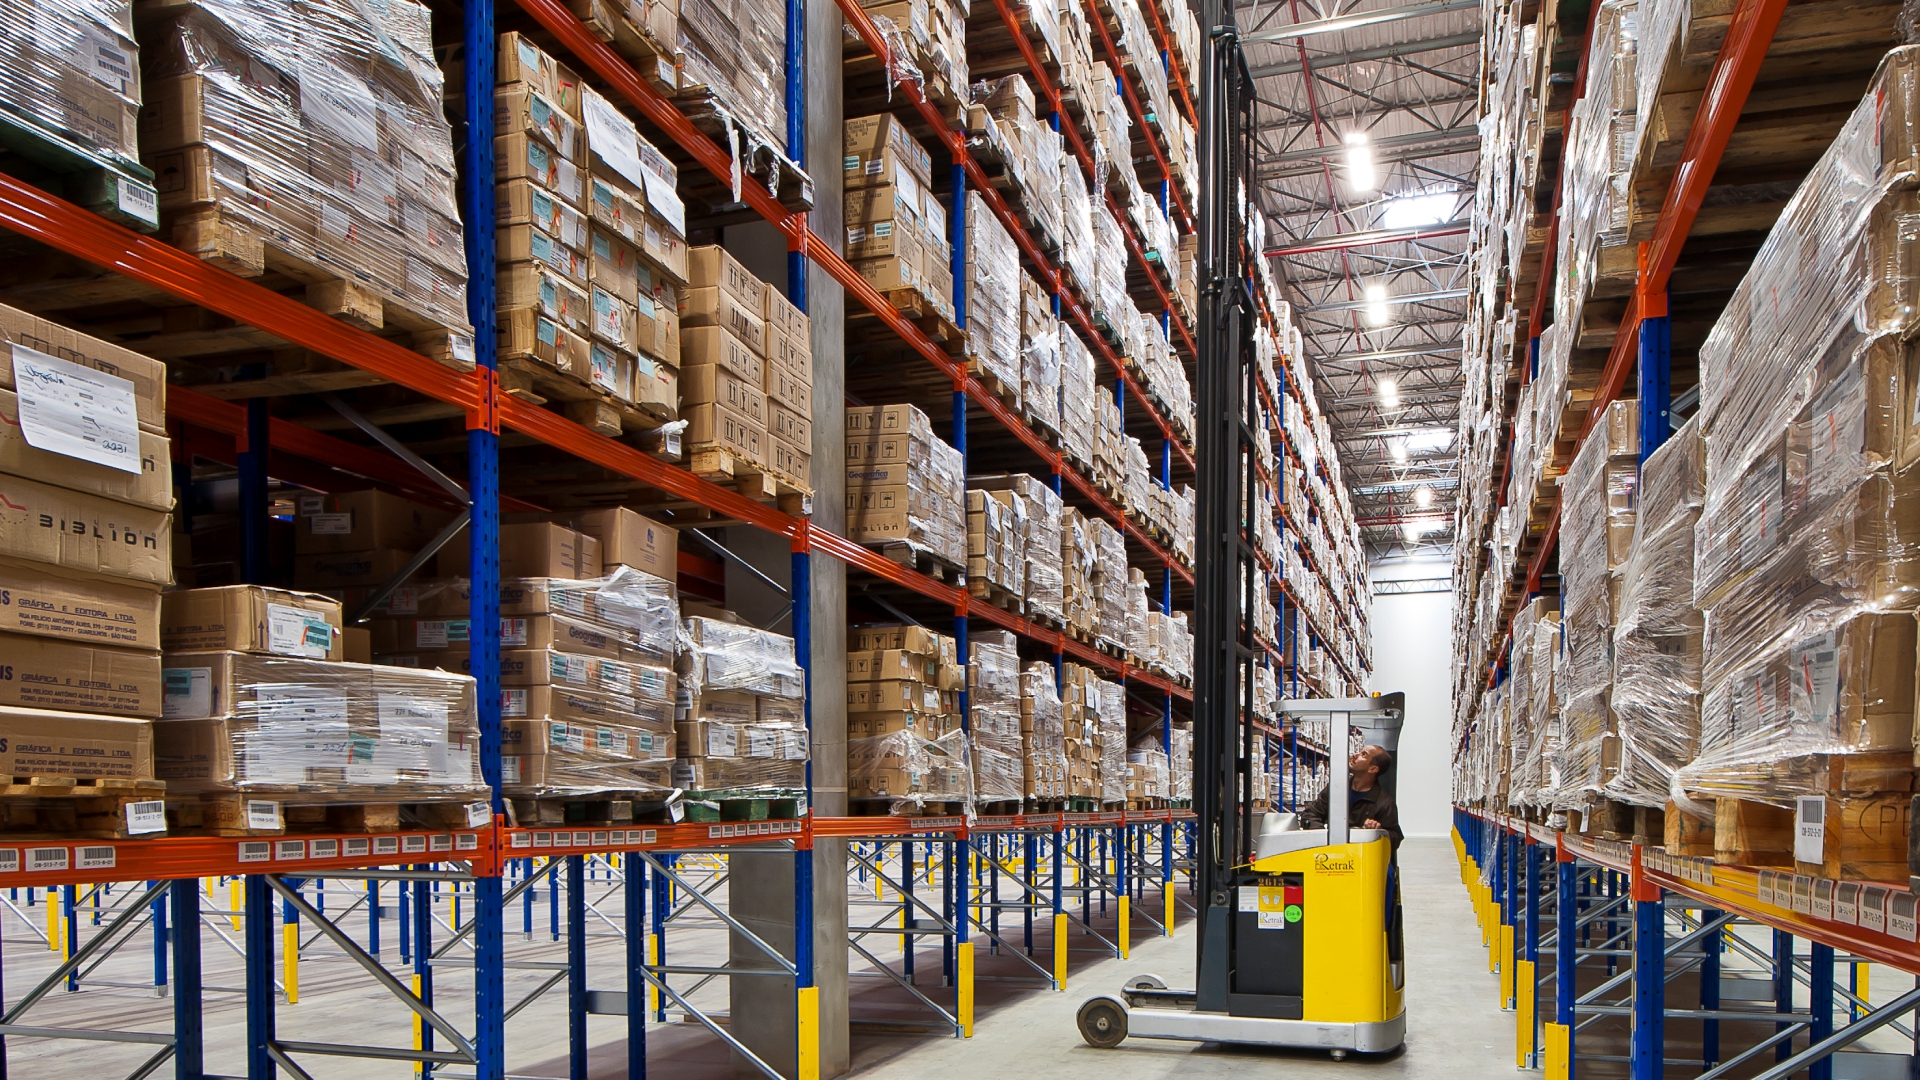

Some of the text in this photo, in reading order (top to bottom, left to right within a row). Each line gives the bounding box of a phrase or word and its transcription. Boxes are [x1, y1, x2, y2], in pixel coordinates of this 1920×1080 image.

[18, 598, 55, 611] GRÁFICA
[75, 607, 108, 618] EDITORA
[19, 612, 31, 620] RUA
[21, 673, 58, 683] GRÁFICA
[79, 680, 112, 689] EDITORA
[15, 744, 52, 753] GRÁFICA
[73, 747, 105, 755] EDITORA
[1315, 853, 1354, 871] Retrak
[1257, 878, 1285, 887] 2613
